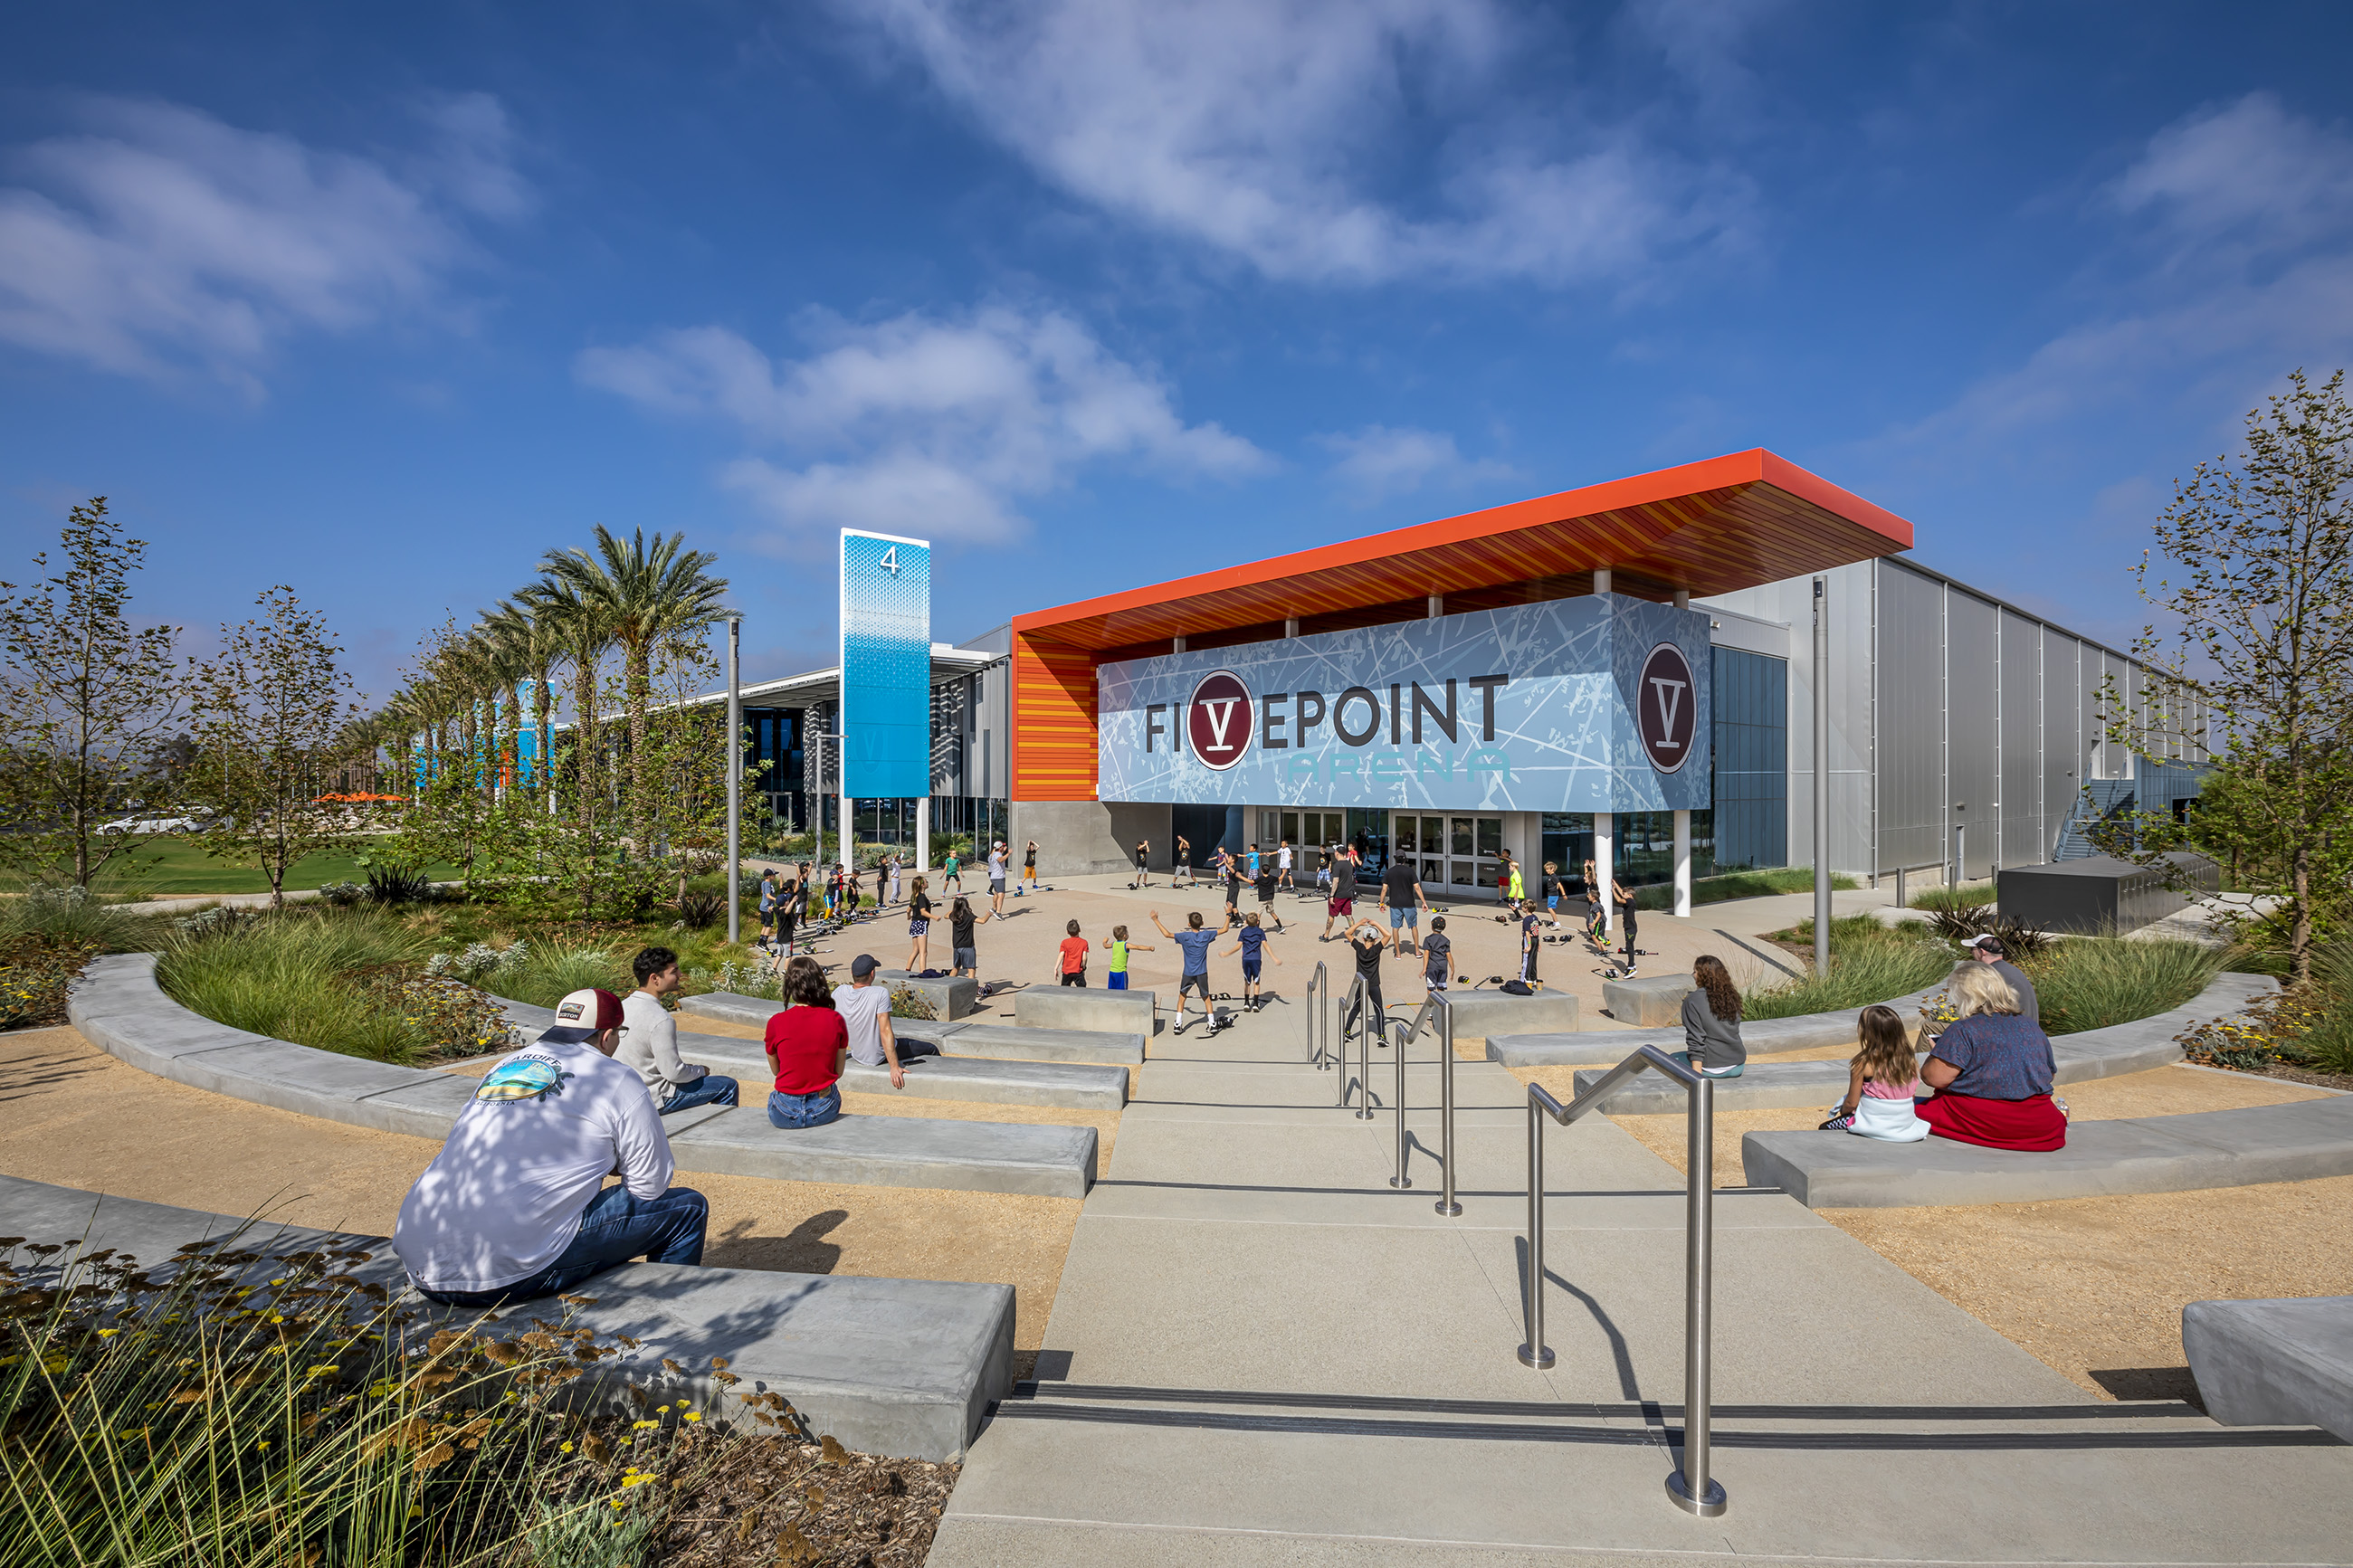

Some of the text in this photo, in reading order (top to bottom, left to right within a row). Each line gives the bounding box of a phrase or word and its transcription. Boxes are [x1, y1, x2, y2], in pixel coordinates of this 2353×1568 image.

[880, 546, 899, 575] 4
[1147, 673, 1510, 753] FIVEPOINT
[1287, 748, 1510, 784] ARENA
[502, 1053, 562, 1066] ARDIFF
